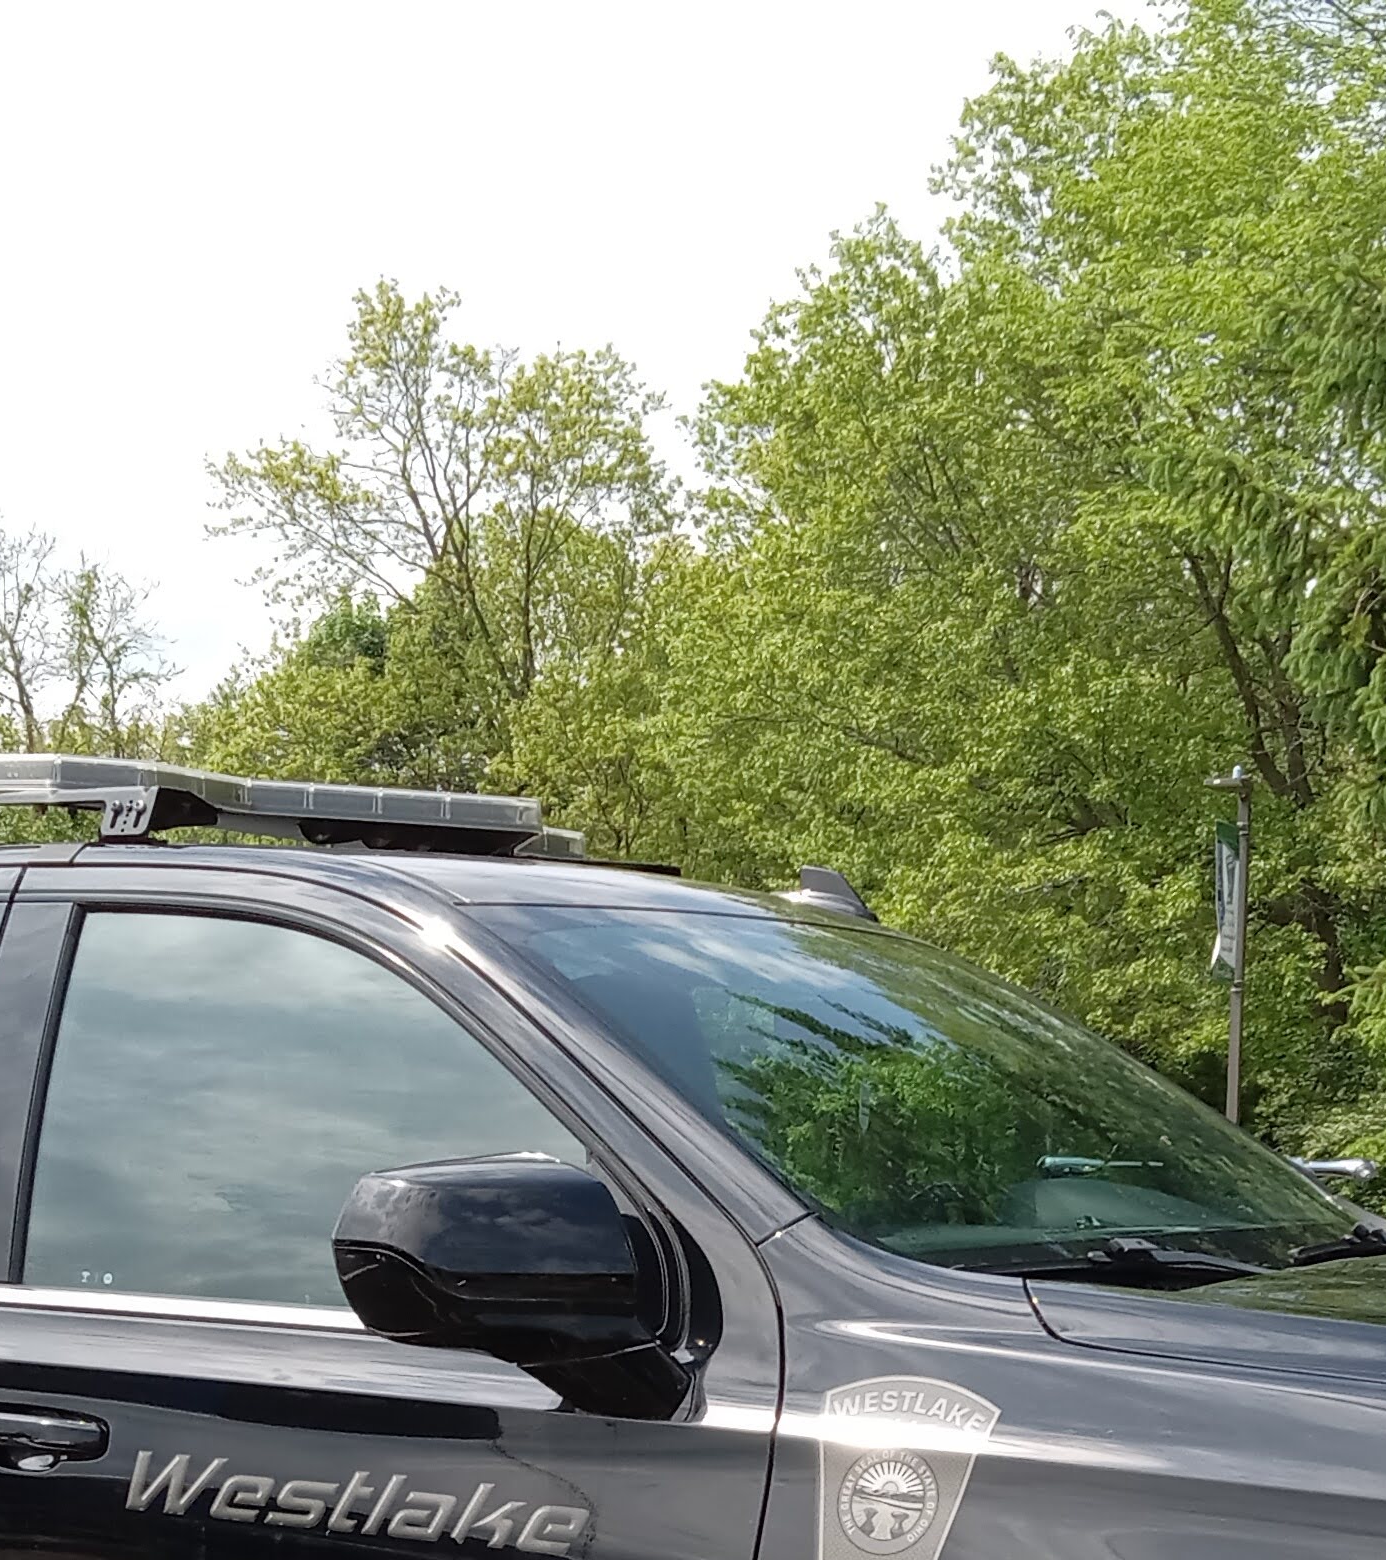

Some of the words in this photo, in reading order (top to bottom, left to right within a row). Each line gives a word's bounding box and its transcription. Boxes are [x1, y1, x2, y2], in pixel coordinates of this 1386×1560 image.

[832, 1390, 987, 1432] WESTLAKE
[854, 1455, 879, 1474] SEAL
[882, 1449, 896, 1459] OF
[900, 1452, 919, 1467] THE
[125, 1450, 591, 1554] Westlake
[906, 1518, 928, 1543] OHIO
